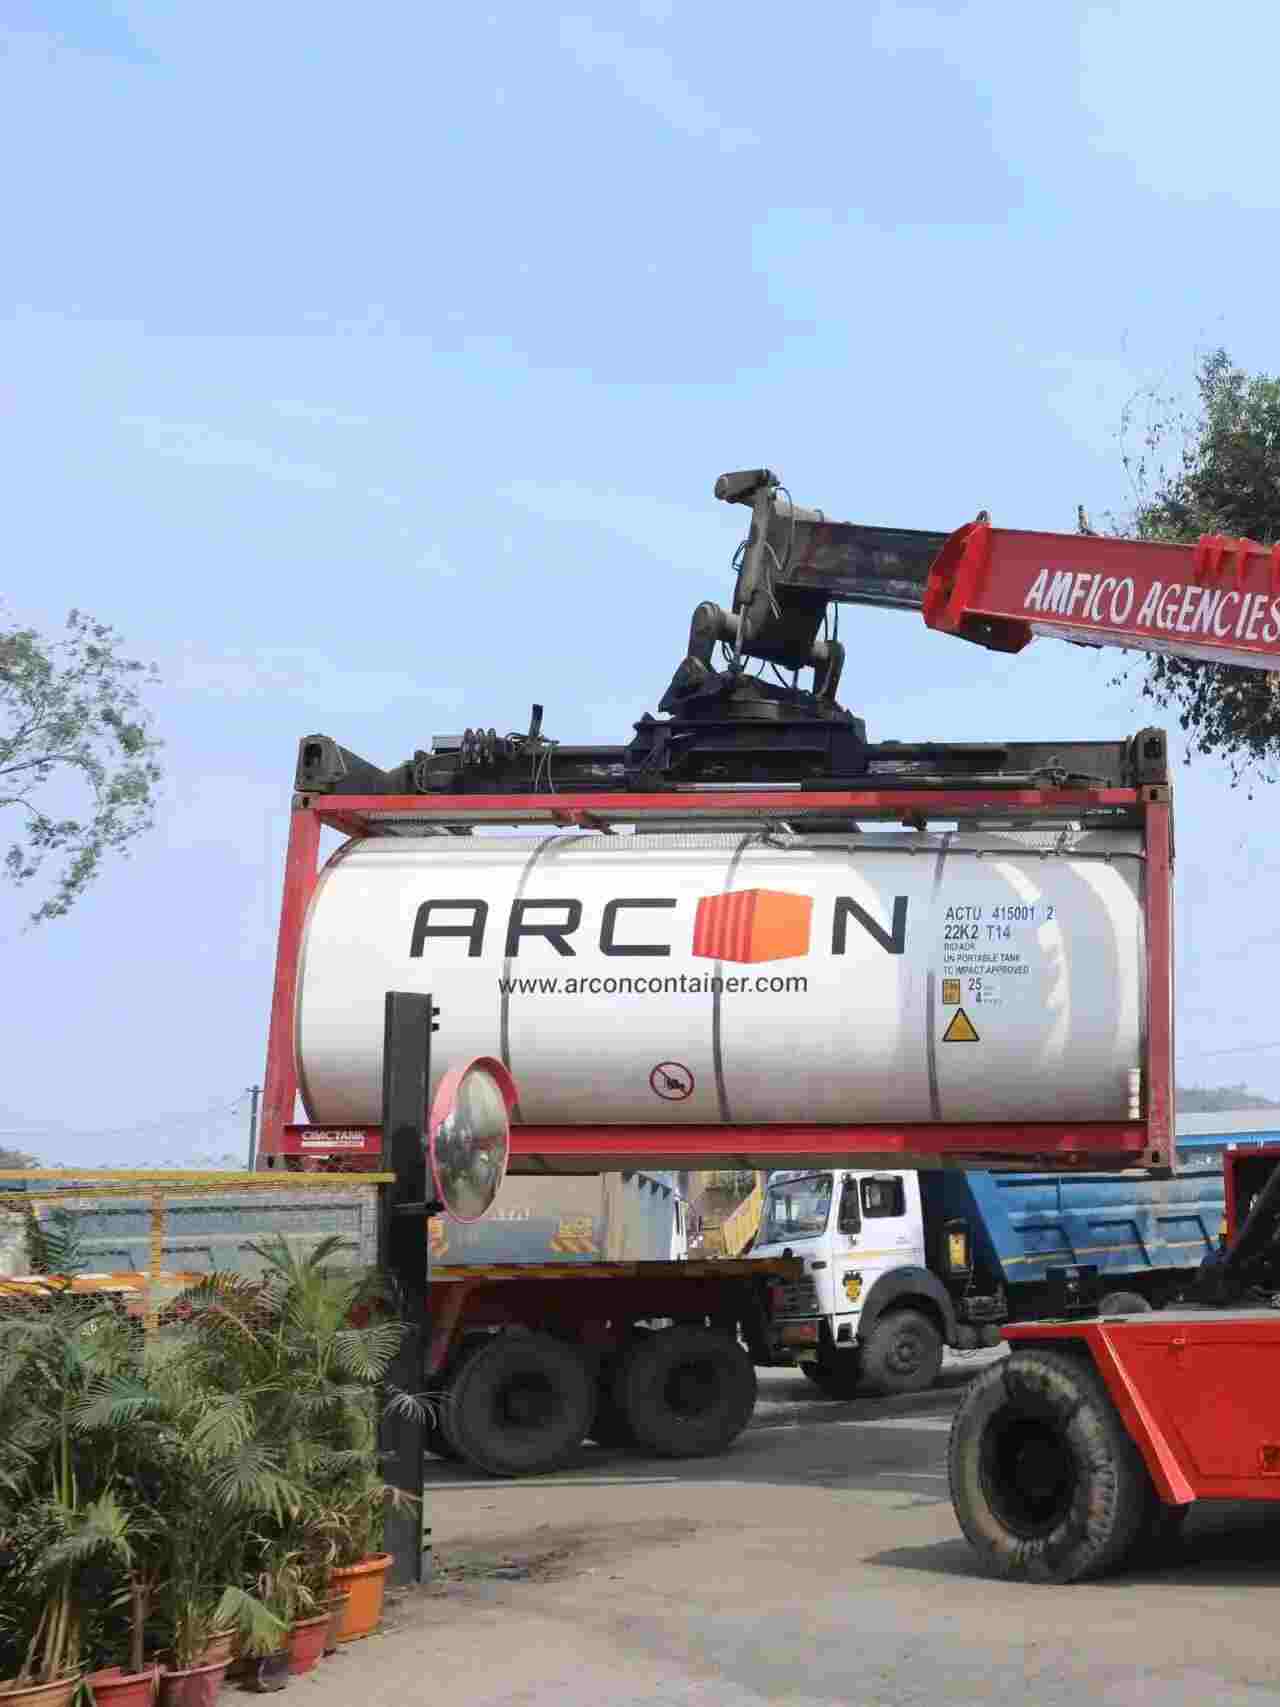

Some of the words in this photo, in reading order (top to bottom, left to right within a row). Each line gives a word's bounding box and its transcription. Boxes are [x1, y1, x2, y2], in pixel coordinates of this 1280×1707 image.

[1024, 568, 1136, 625] AMFICO
[944, 906, 981, 920] ACTU
[992, 906, 1035, 920] 415001
[944, 924, 978, 939] 22K2
[986, 925, 1010, 939] T14
[498, 973, 808, 994] www.arconcontainer.com
